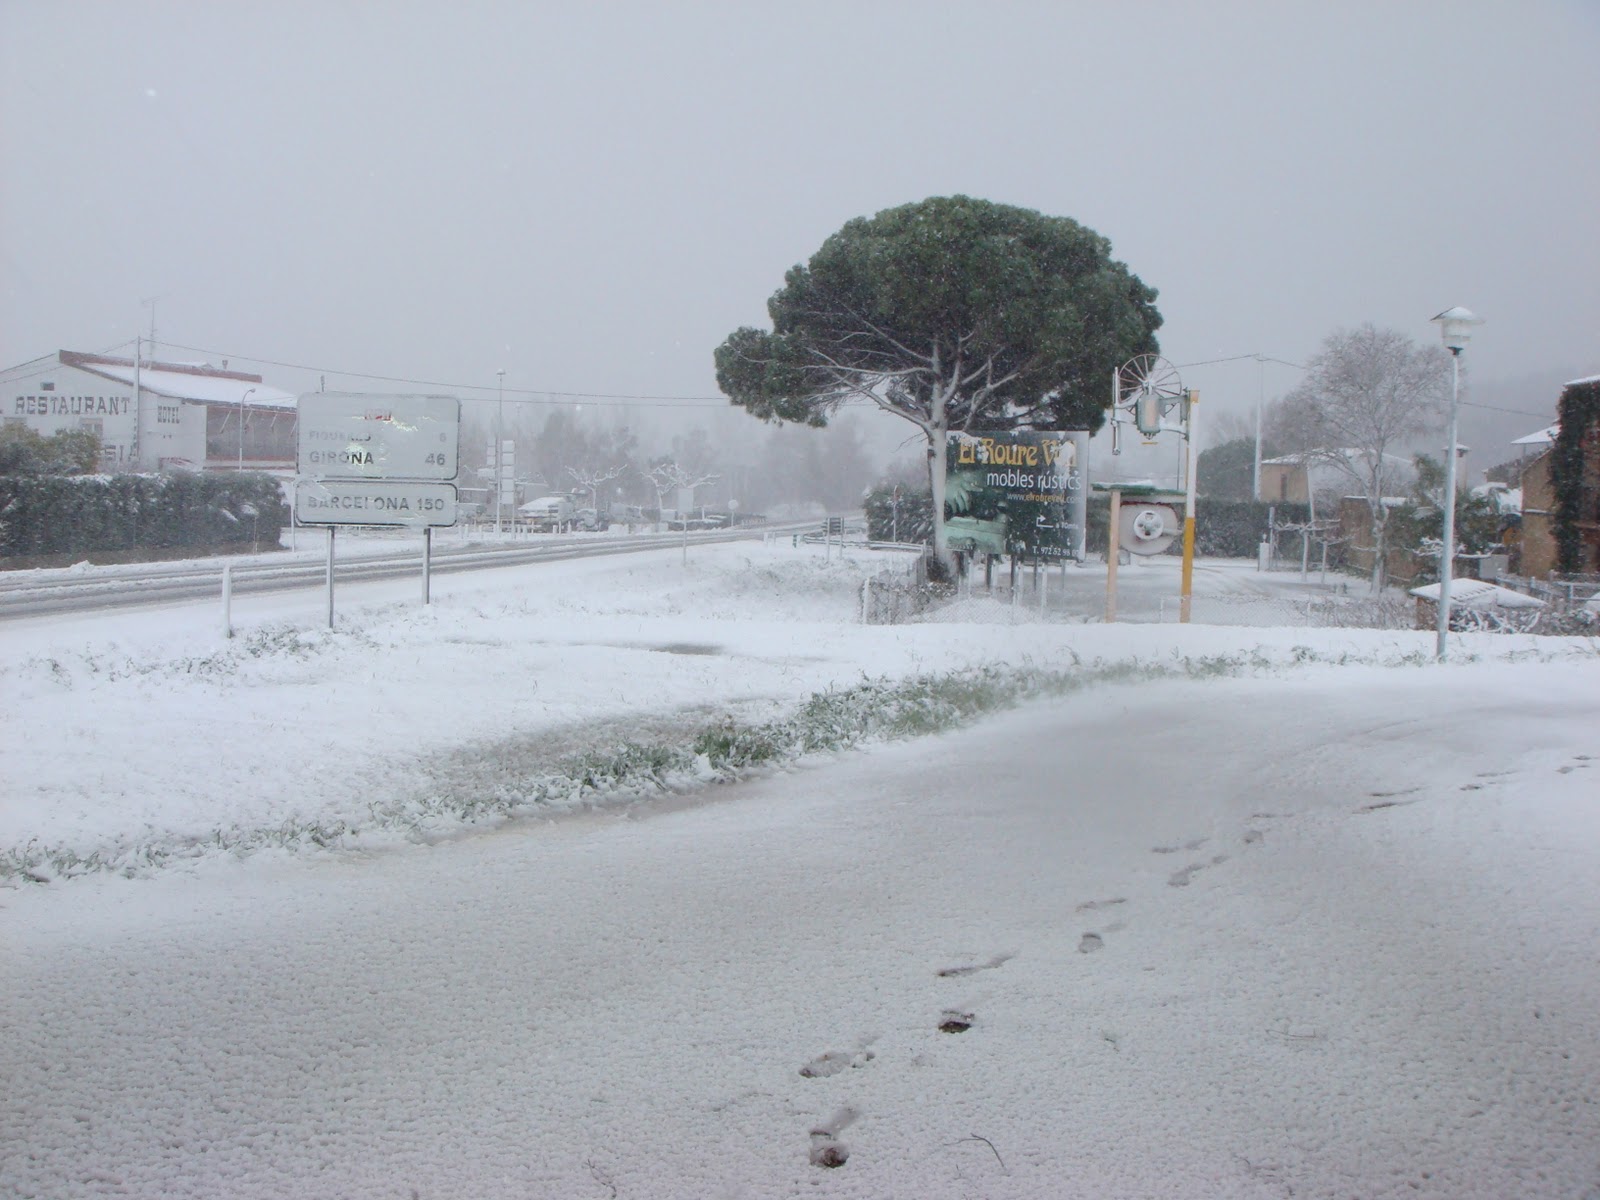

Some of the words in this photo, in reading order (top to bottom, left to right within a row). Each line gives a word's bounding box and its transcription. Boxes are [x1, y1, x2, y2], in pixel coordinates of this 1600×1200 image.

[14, 395, 130, 415] RESTAURANT
[309, 450, 374, 465] GIRONA
[425, 453, 447, 466] 46
[958, 437, 975, 464] El
[980, 437, 1038, 466] Roure
[987, 469, 1034, 487] mobles
[1037, 470, 1082, 490] rústics
[307, 496, 410, 511] BARCELONA
[417, 497, 445, 511] 150
